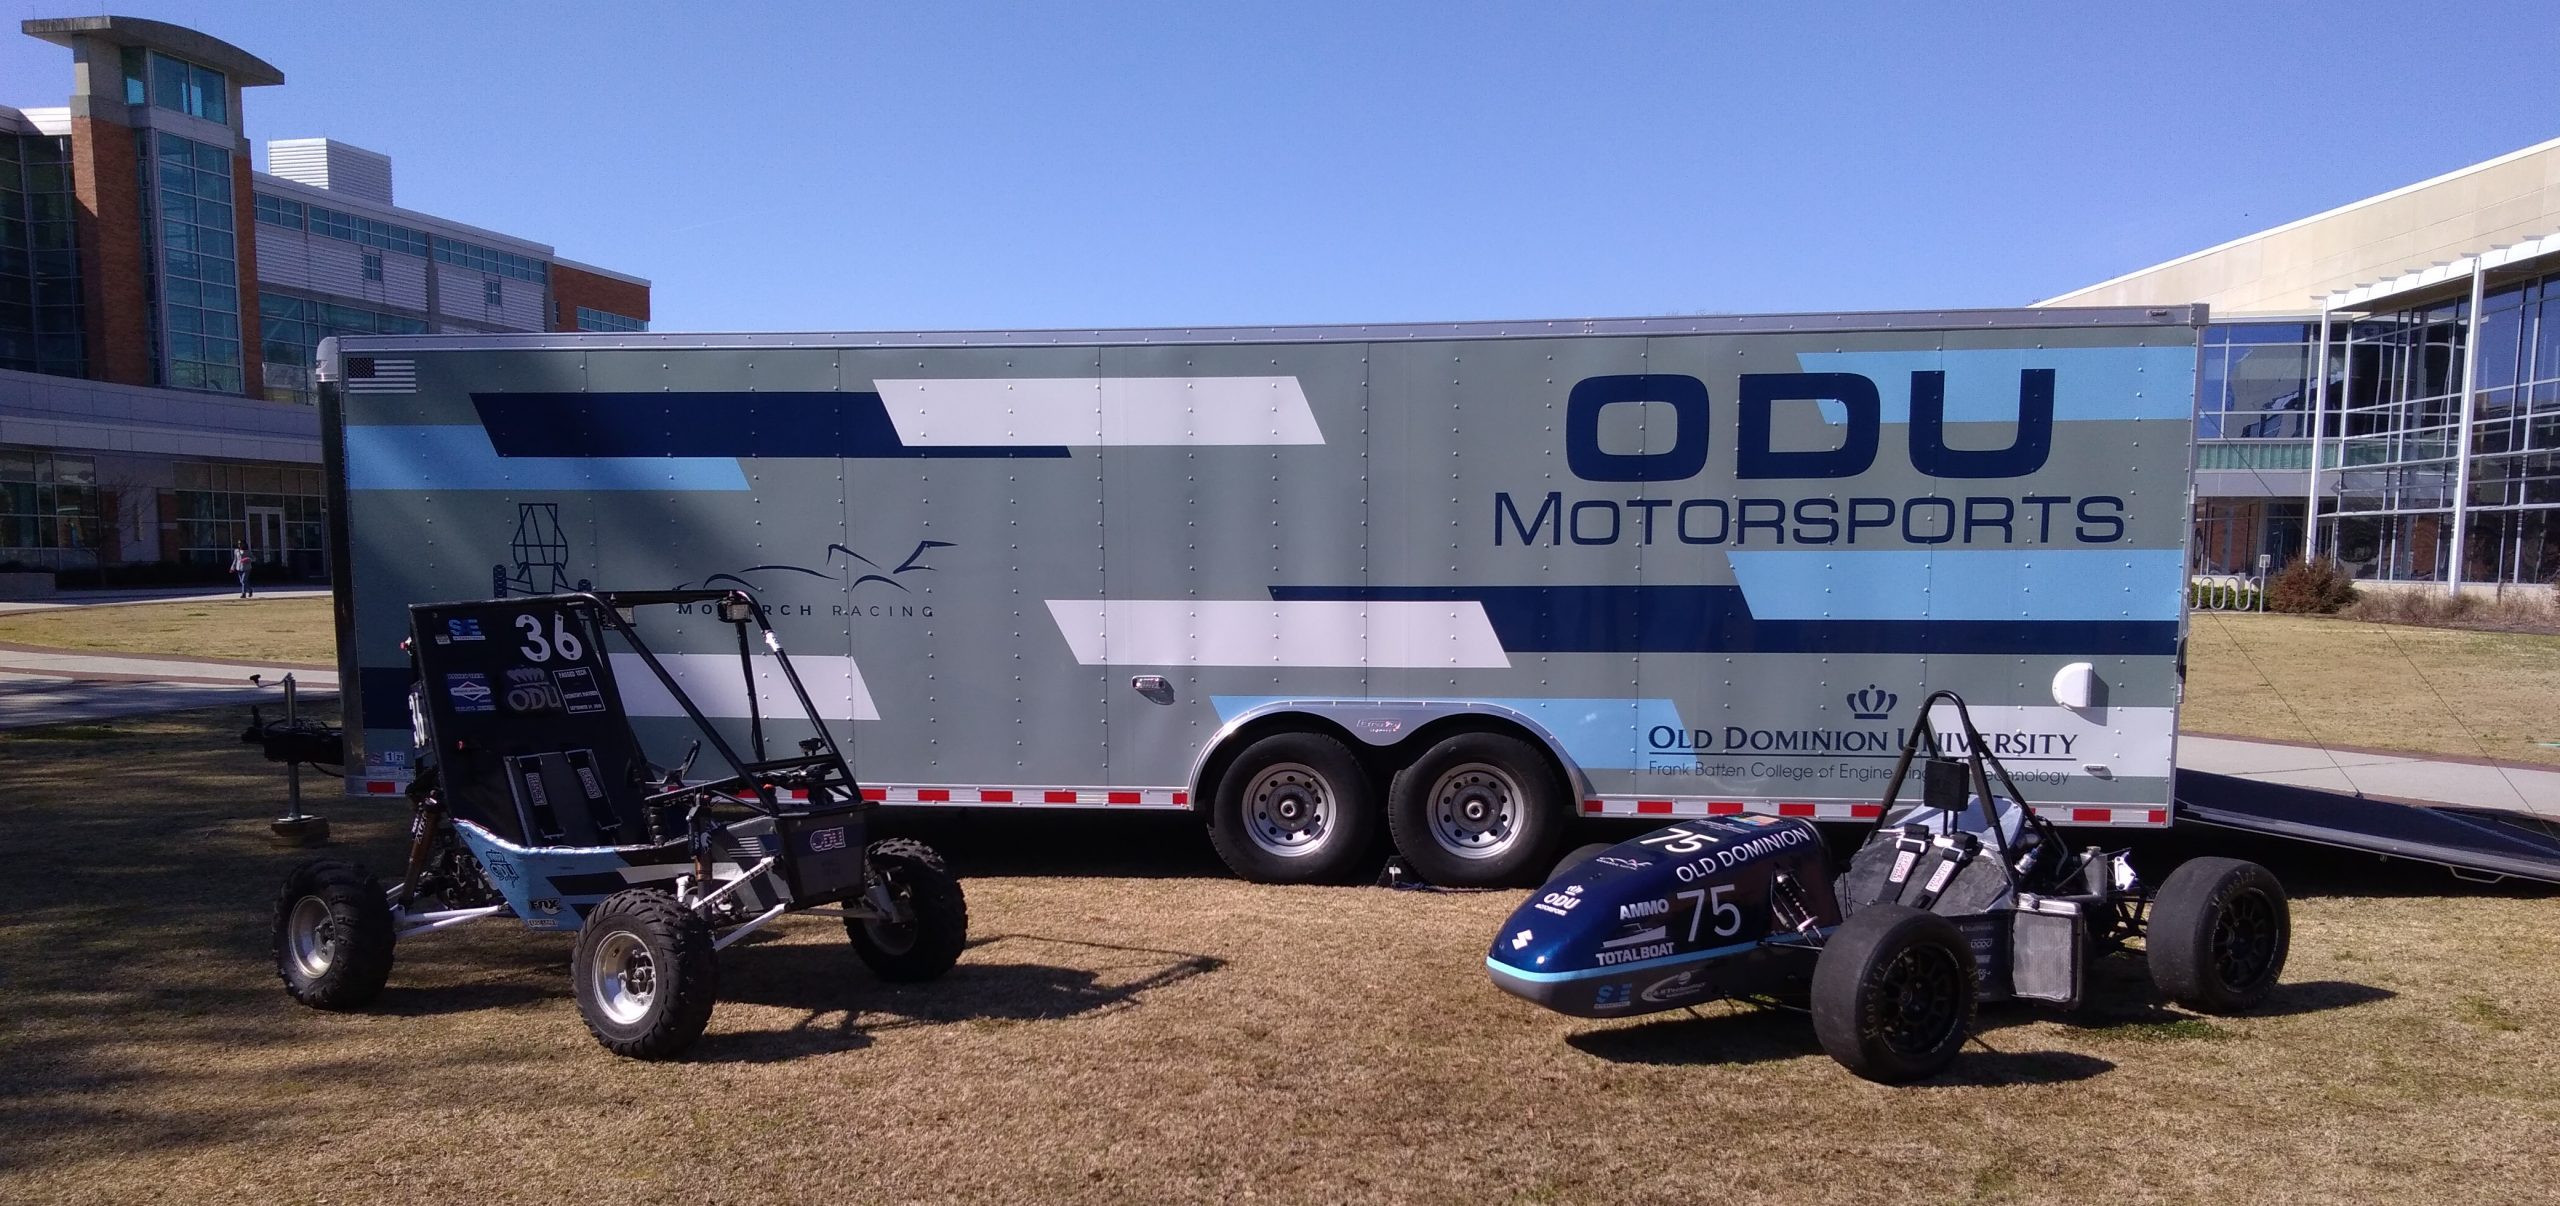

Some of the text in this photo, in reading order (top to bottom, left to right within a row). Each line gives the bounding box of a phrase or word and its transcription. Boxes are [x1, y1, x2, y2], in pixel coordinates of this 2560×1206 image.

[1566, 368, 2055, 482] ODU
[1495, 491, 2125, 546] MOTORSPORTS
[677, 603, 933, 617] MORCH RACING
[515, 611, 582, 662] 36
[507, 685, 561, 711] ODU
[1648, 725, 1713, 749] OLD
[1724, 726, 1889, 752] DOMINION
[1648, 760, 1690, 776] Frank
[1695, 761, 1746, 777] Batten
[1750, 762, 1813, 781] College
[1819, 764, 1836, 778] of
[1984, 768, 2071, 786] echnology
[1640, 827, 1720, 853] 75
[1675, 857, 1717, 883] OLD
[1716, 827, 1811, 868] DOMINION
[1543, 892, 1581, 910] ODU
[1619, 898, 1670, 920] AMMO
[1676, 884, 1742, 942] 75
[1595, 942, 1675, 967] TOTALBOAT
